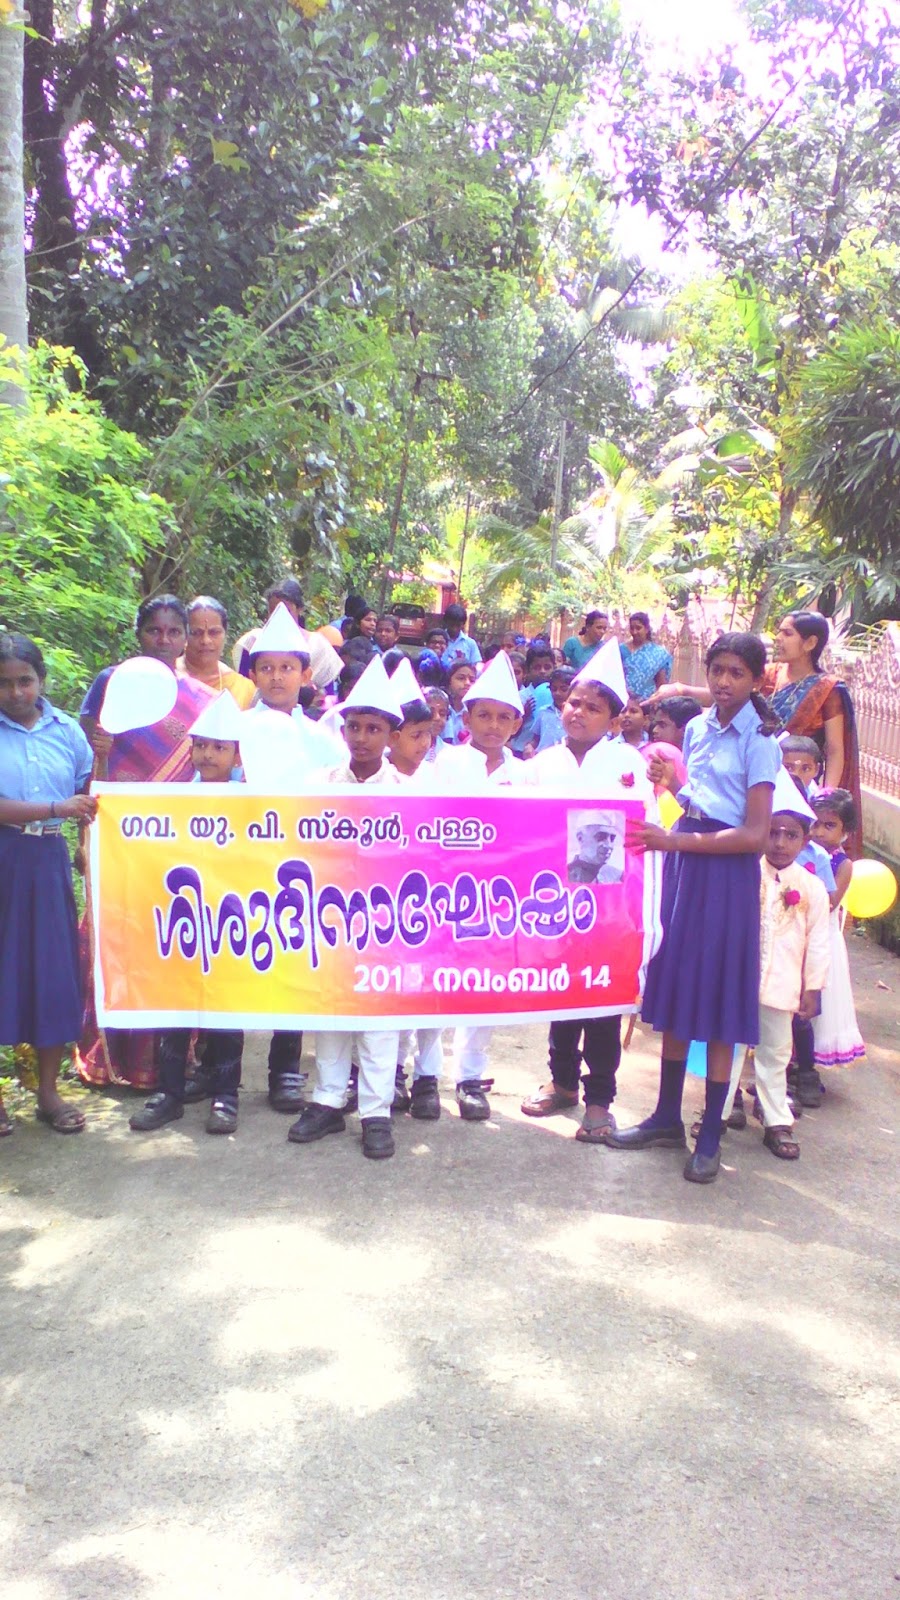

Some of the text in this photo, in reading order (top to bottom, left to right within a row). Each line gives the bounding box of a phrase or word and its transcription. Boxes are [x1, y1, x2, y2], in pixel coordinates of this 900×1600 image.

[121, 810, 495, 848] ഗവ. യു. പി. സ്കൂൾ, പള്ളം
[154, 859, 595, 973] ശിശുദിനാഘോഷം
[432, 962, 570, 993] നവംബർ
[580, 964, 612, 989] 14
